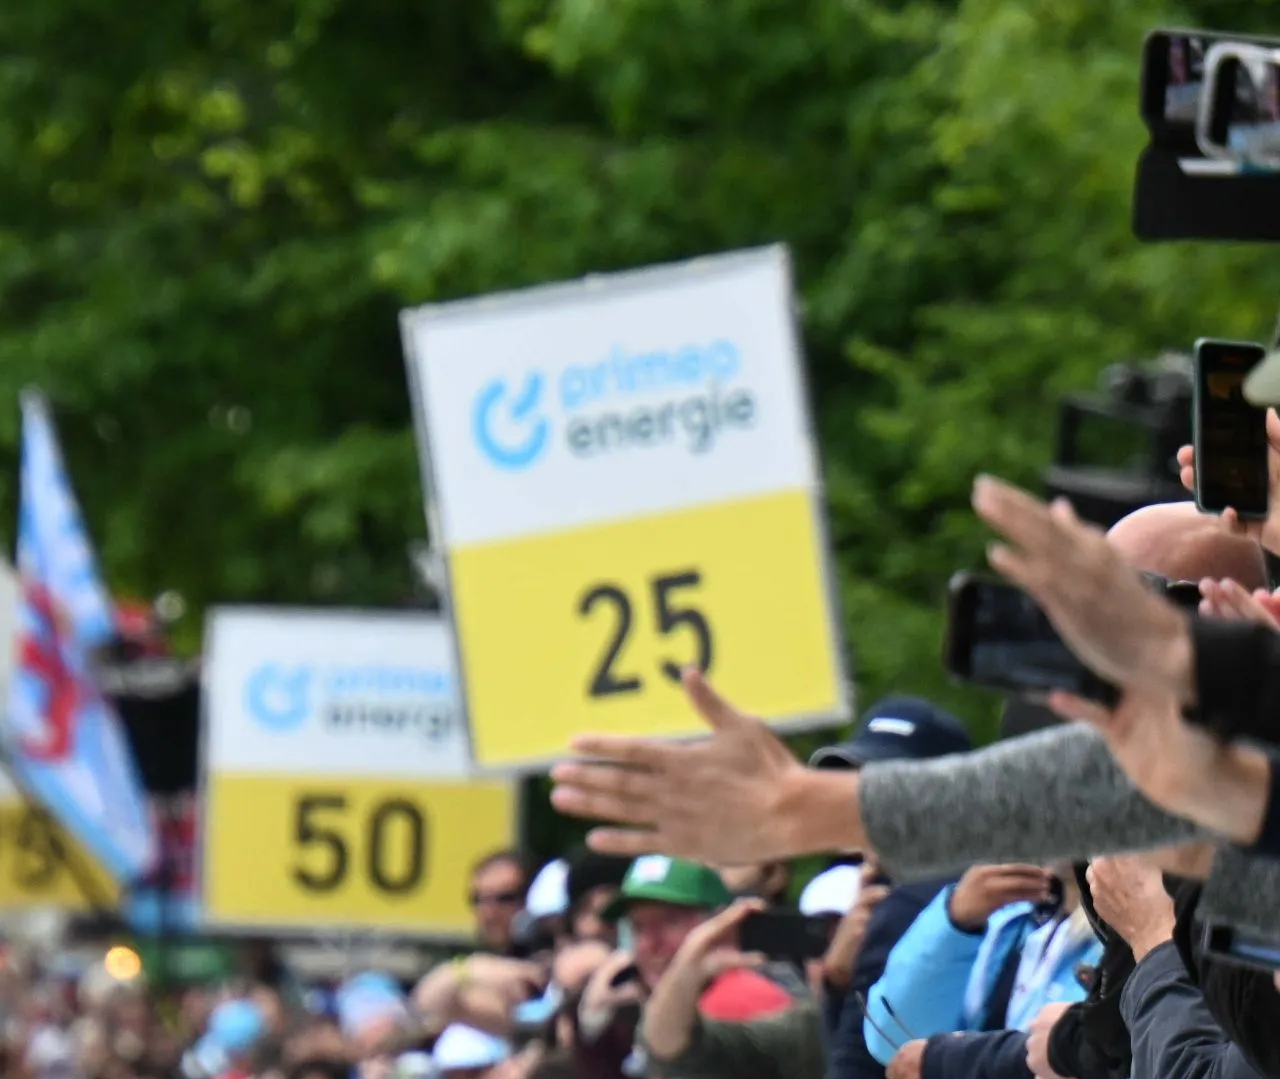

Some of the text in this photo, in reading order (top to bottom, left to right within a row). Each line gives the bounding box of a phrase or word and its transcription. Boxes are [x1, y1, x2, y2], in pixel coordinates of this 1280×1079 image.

[557, 337, 742, 410] primeo
[564, 378, 758, 456] energie
[577, 566, 714, 699] 25
[292, 792, 429, 898] 50
